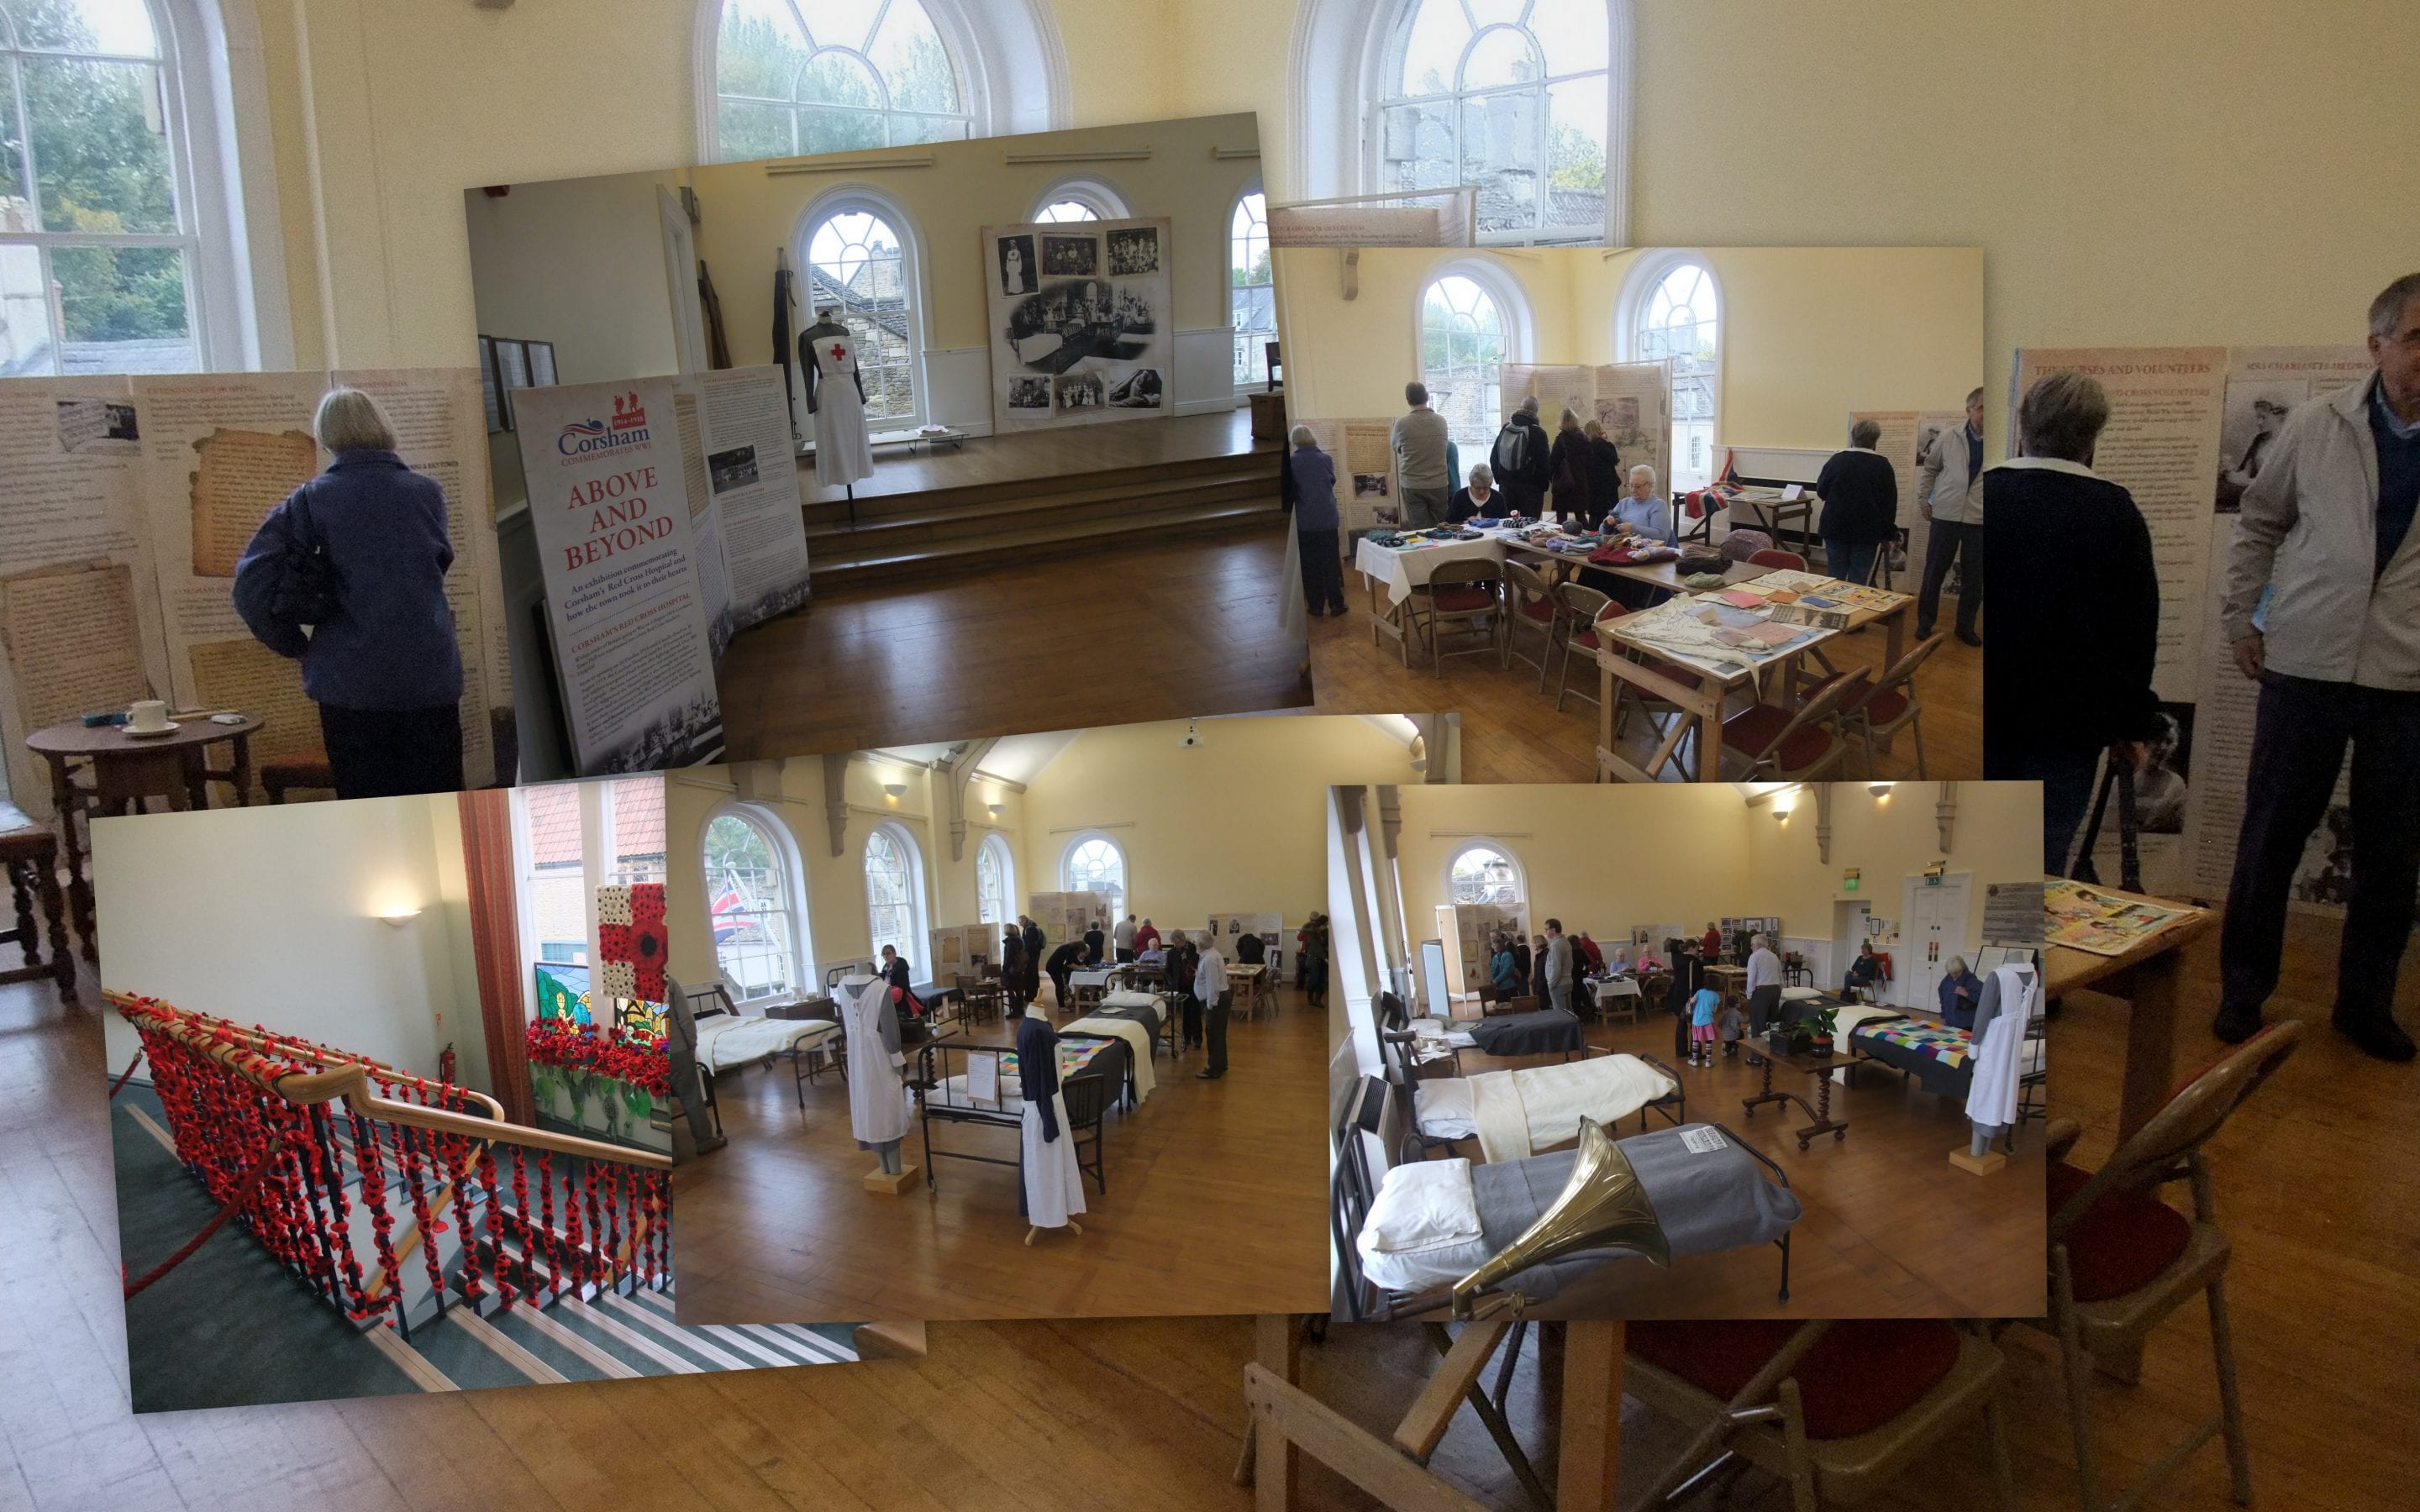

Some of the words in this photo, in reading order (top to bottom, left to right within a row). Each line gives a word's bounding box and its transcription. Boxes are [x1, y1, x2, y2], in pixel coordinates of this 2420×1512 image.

[558, 427, 650, 456] Corsham
[561, 447, 634, 467] COMMEMORATES
[567, 466, 659, 511] ABOVE
[589, 497, 647, 534] AND
[563, 516, 673, 571] BEYOND
[564, 587, 606, 610] Corsham's
[608, 578, 623, 591] Red
[623, 572, 644, 585] Cross
[644, 560, 672, 578] Hospital
[673, 554, 686, 565] and
[566, 610, 584, 622] how
[586, 603, 598, 614] the
[599, 596, 618, 608] town
[618, 588, 634, 599] took
[643, 580, 651, 589] to
[651, 573, 666, 585] their
[667, 565, 688, 579] hearts
[571, 585, 583, 595] An
[585, 569, 623, 590] exhibition
[623, 548, 678, 573] commemorating
[571, 626, 618, 654] CORSHAM'S
[618, 617, 634, 631] RED
[634, 608, 658, 623] CROSS
[658, 591, 692, 612] HOSPITAL
